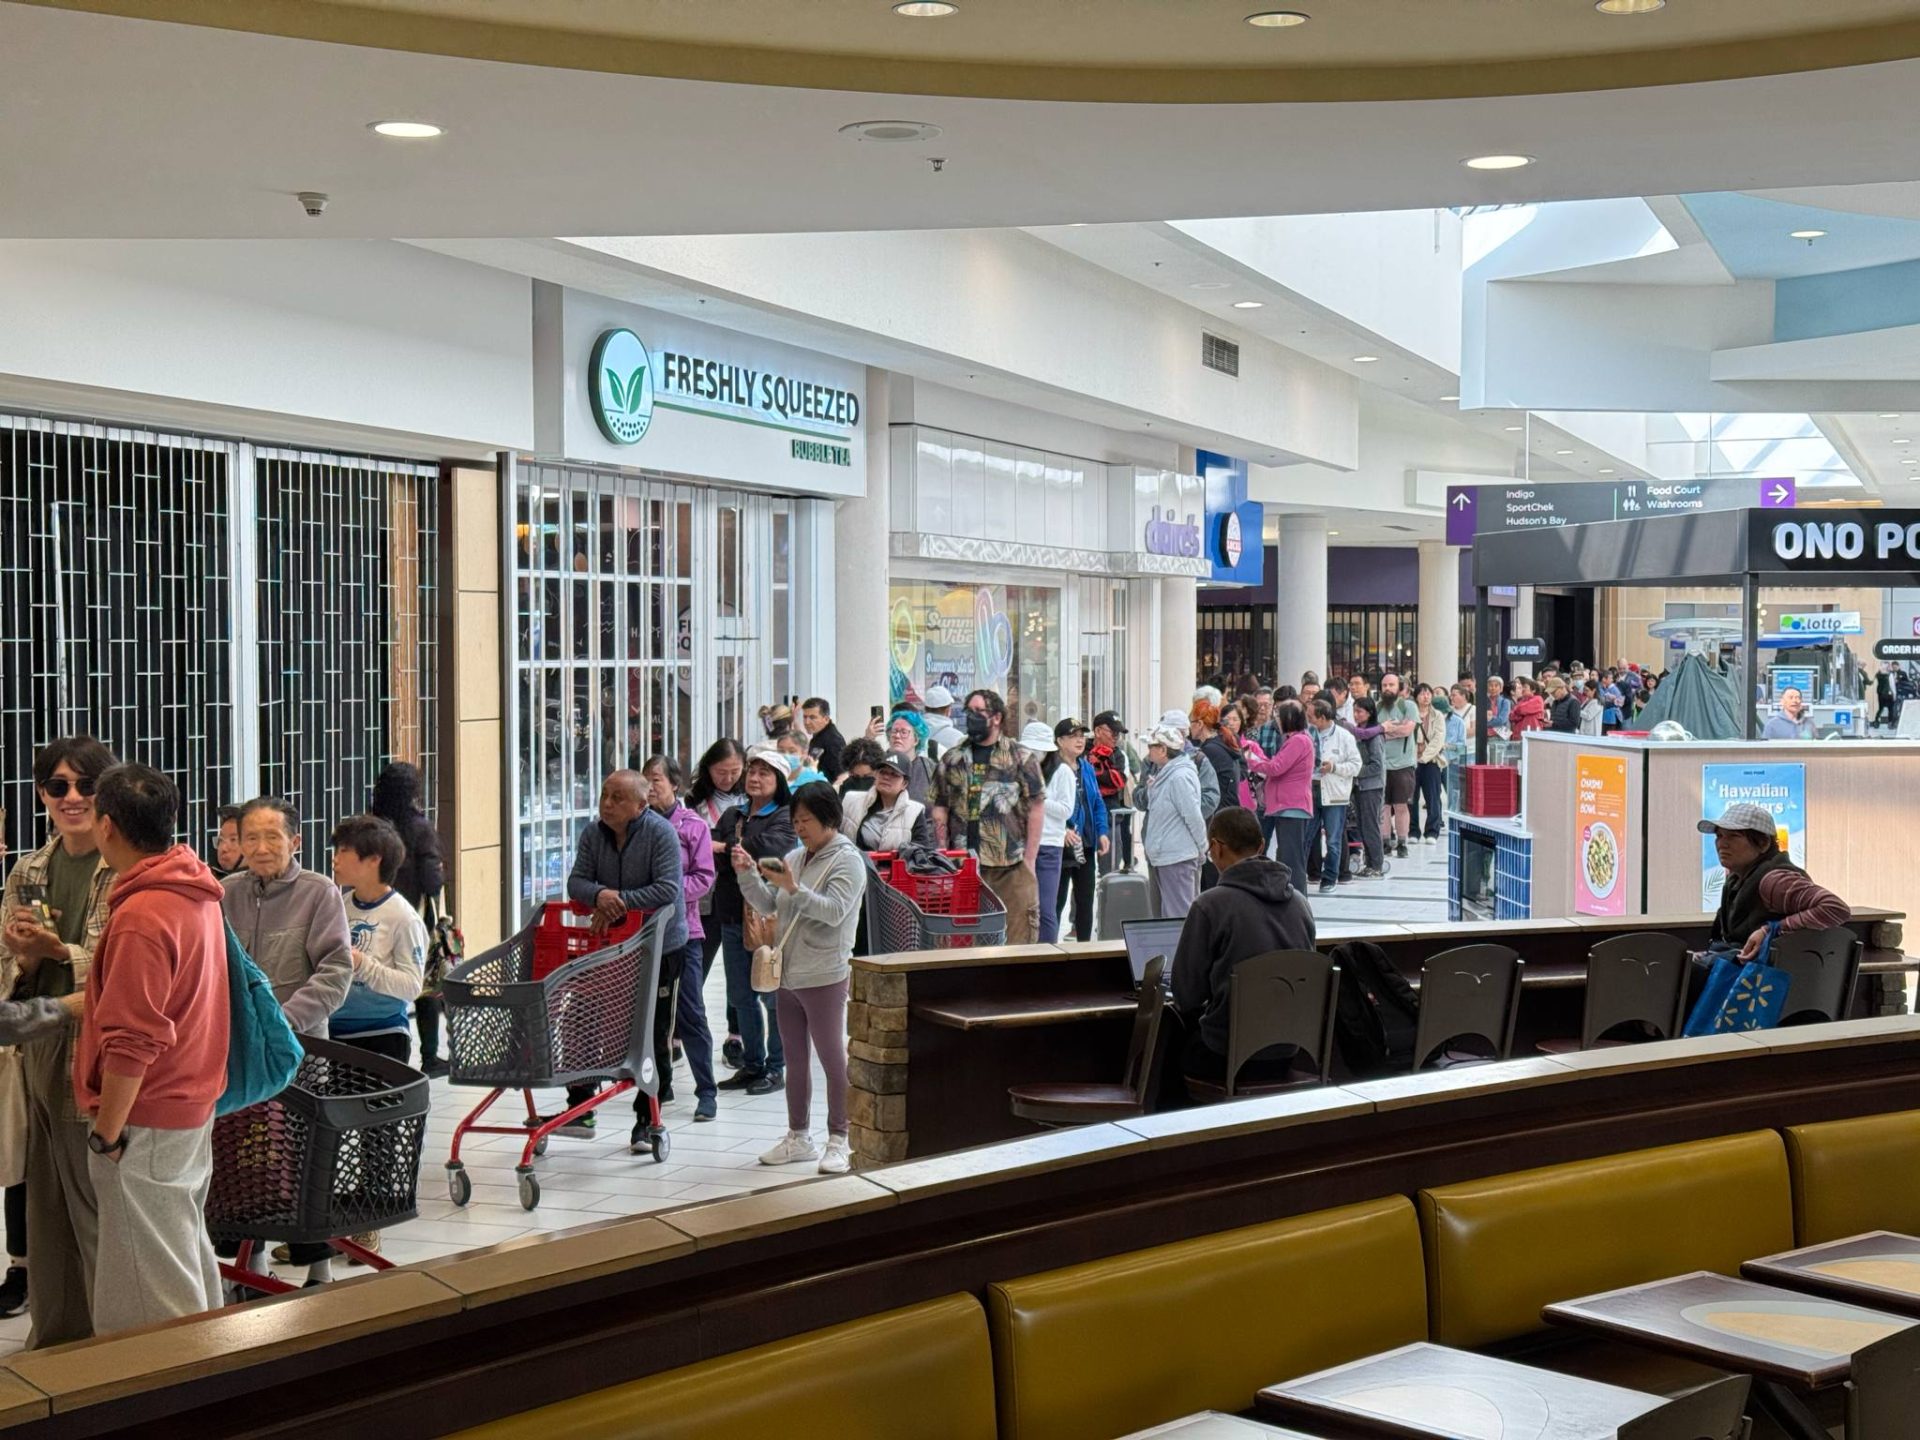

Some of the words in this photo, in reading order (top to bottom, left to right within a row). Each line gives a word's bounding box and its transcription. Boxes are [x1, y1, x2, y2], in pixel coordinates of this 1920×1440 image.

[663, 352, 756, 407] FRESHLY
[761, 373, 860, 427] SQUEEZED
[1506, 490, 1536, 500] Indigo
[1647, 486, 1672, 495] Food
[1673, 485, 1701, 495] Court
[1506, 502, 1554, 513] SportChek
[1647, 500, 1703, 509] Washrooms
[1506, 516, 1547, 525] Hudson's
[1549, 516, 1567, 526] Bay
[1774, 522, 1864, 560] ONO
[1807, 617, 1842, 630] lotto
[1882, 645, 1911, 654] ORDER
[1719, 783, 1790, 798] Hawaiian
[1726, 799, 1785, 814] Cers
